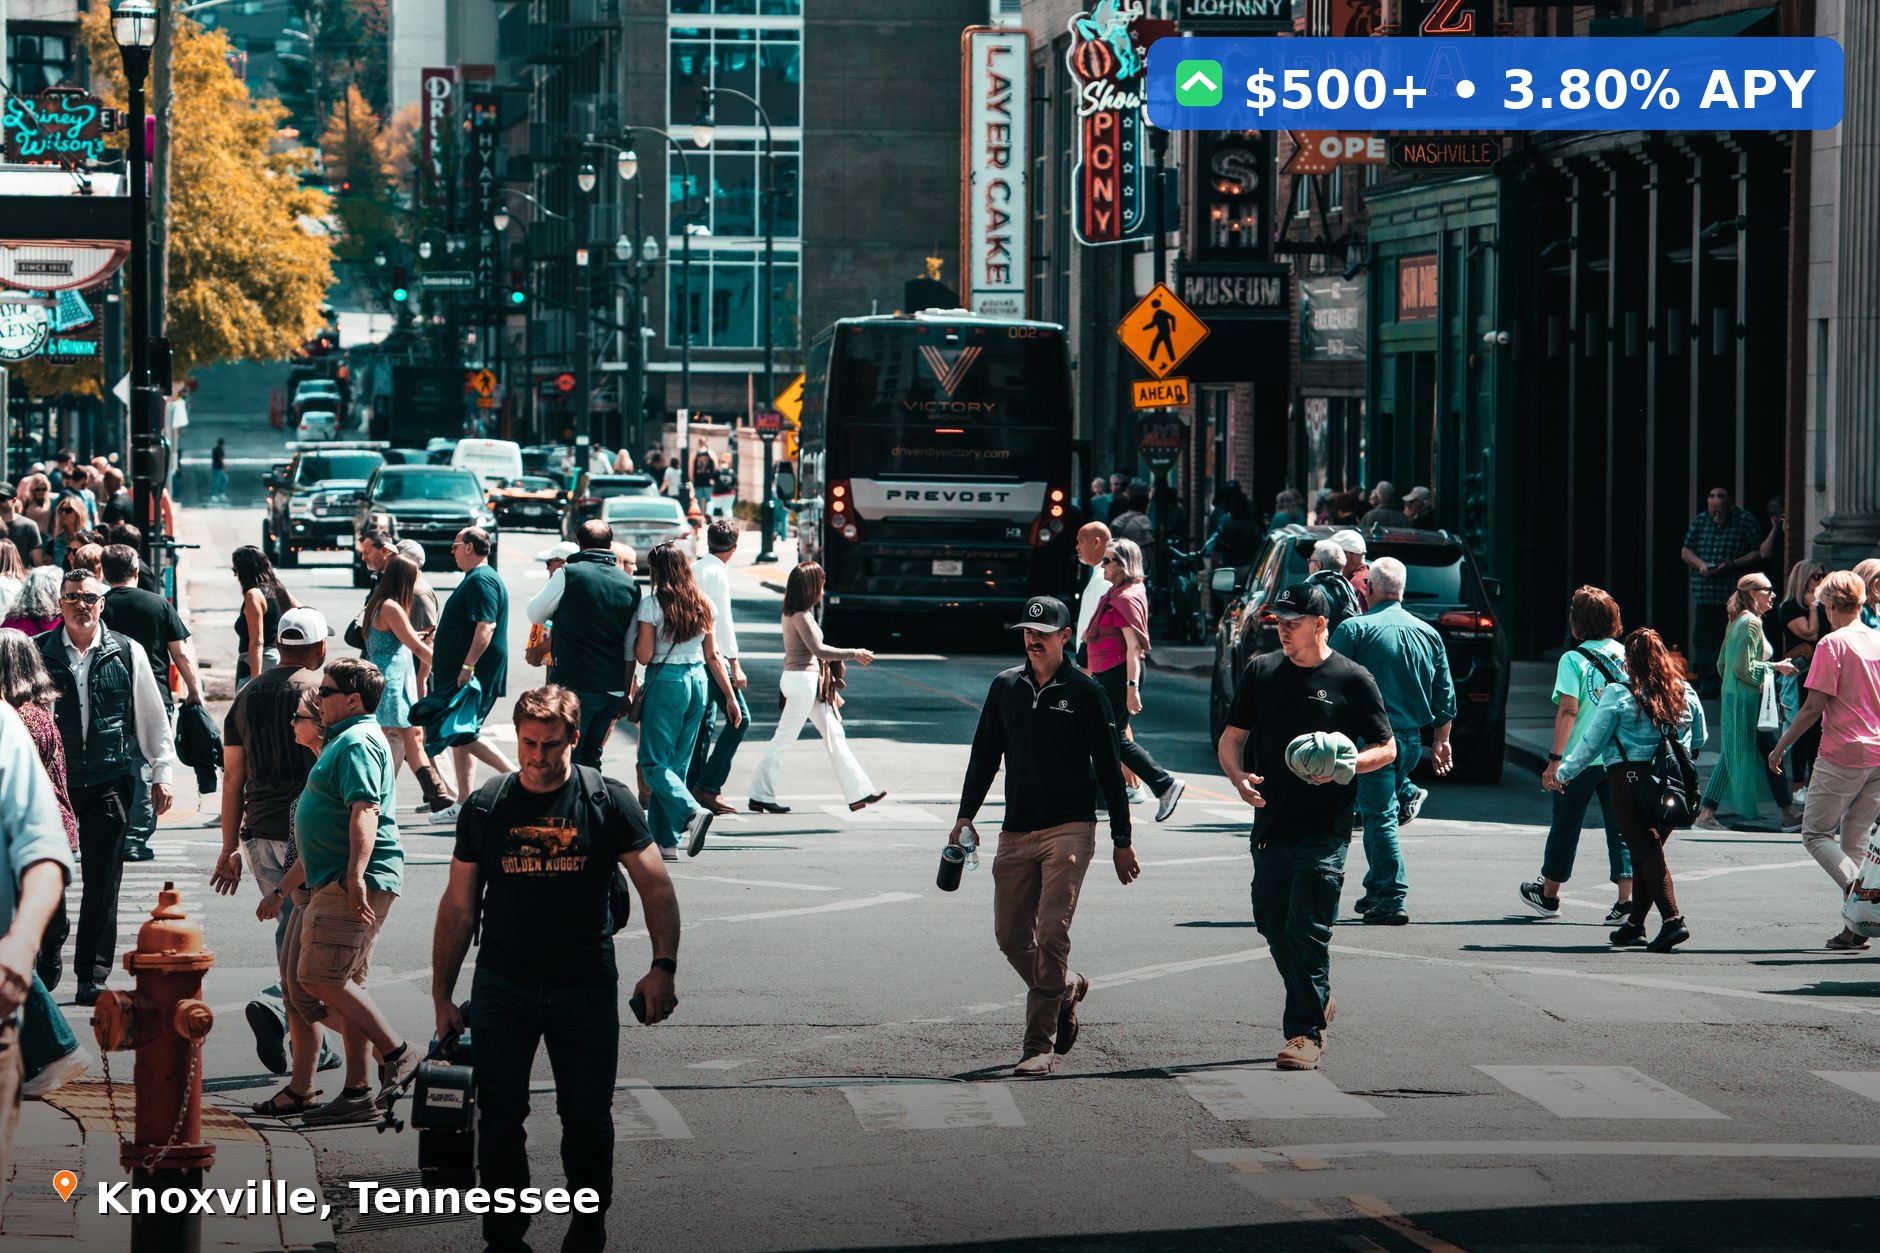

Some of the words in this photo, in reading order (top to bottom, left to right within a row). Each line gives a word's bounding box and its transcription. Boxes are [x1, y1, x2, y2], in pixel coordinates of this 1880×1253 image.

[1186, 0, 1280, 16] JOHNNY
[985, 45, 1012, 168] LAYER
[1405, 143, 1491, 164] NASHVILLE
[479, 133, 492, 211] HYATT
[1092, 112, 1113, 234] PONY
[985, 177, 1012, 284] CAKE
[21, 263, 46, 271] SINCE
[1184, 277, 1281, 306] MUSEUM
[1008, 327, 1037, 338] 002
[1140, 384, 1184, 402] AHEAD
[903, 401, 996, 413] VICTORY
[891, 446, 1010, 460] drivenbyvictory.com
[886, 490, 1010, 503] PREVOST
[252, 681, 305, 691] ARIAT
[501, 857, 542, 874] GOLDEN
[545, 856, 588, 871] NUGGET
